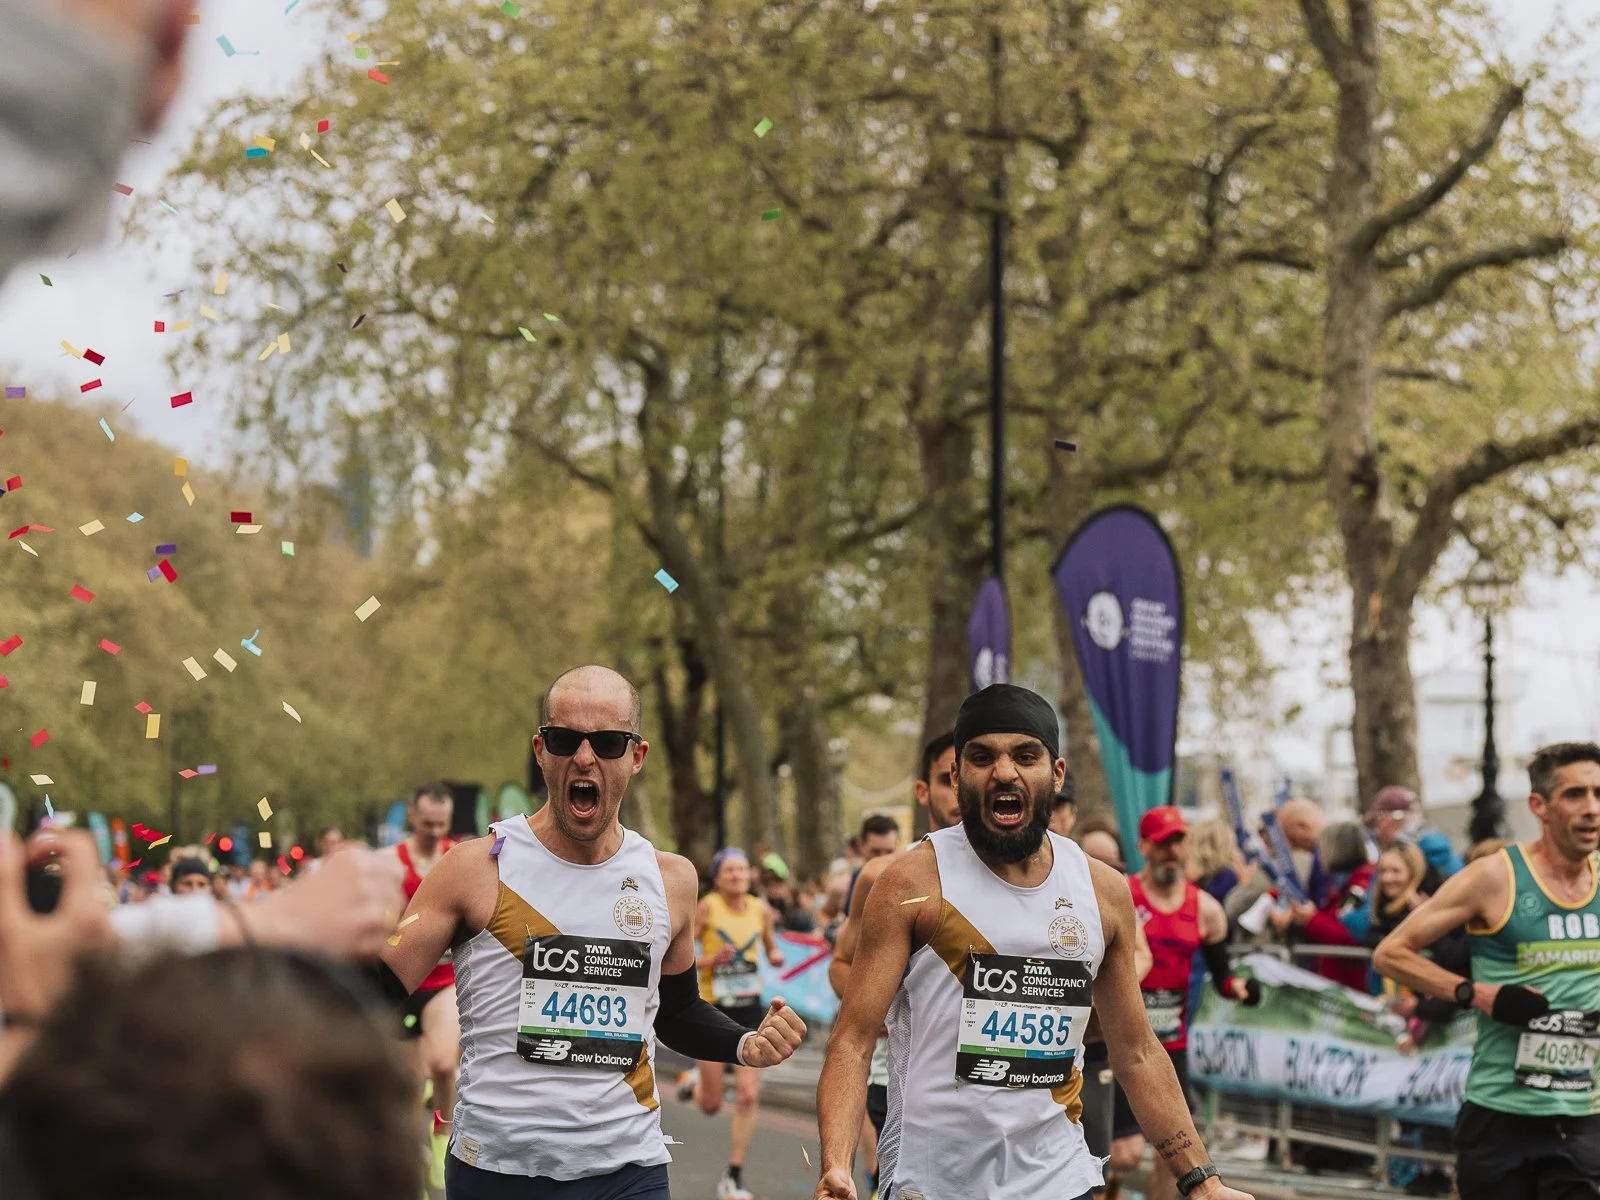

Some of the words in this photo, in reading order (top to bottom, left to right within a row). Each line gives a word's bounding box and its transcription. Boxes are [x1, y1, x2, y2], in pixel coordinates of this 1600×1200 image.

[1548, 913, 1600, 940] ROB
[584, 944, 612, 955] TATA
[533, 941, 580, 974] tcs
[584, 955, 645, 969] CONSULTANCY
[583, 966, 622, 977] SERVICES
[973, 960, 1018, 994] tcs
[1023, 965, 1052, 976] TATA
[1022, 975, 1087, 988] CONSULTANCY
[1021, 986, 1065, 998] SERVICES
[541, 991, 627, 1028] 44693
[981, 1010, 1073, 1046] 44585
[571, 1053, 594, 1063] new
[594, 1053, 633, 1066] balance
[1009, 1073, 1031, 1083] new
[1031, 1073, 1065, 1084] balance
